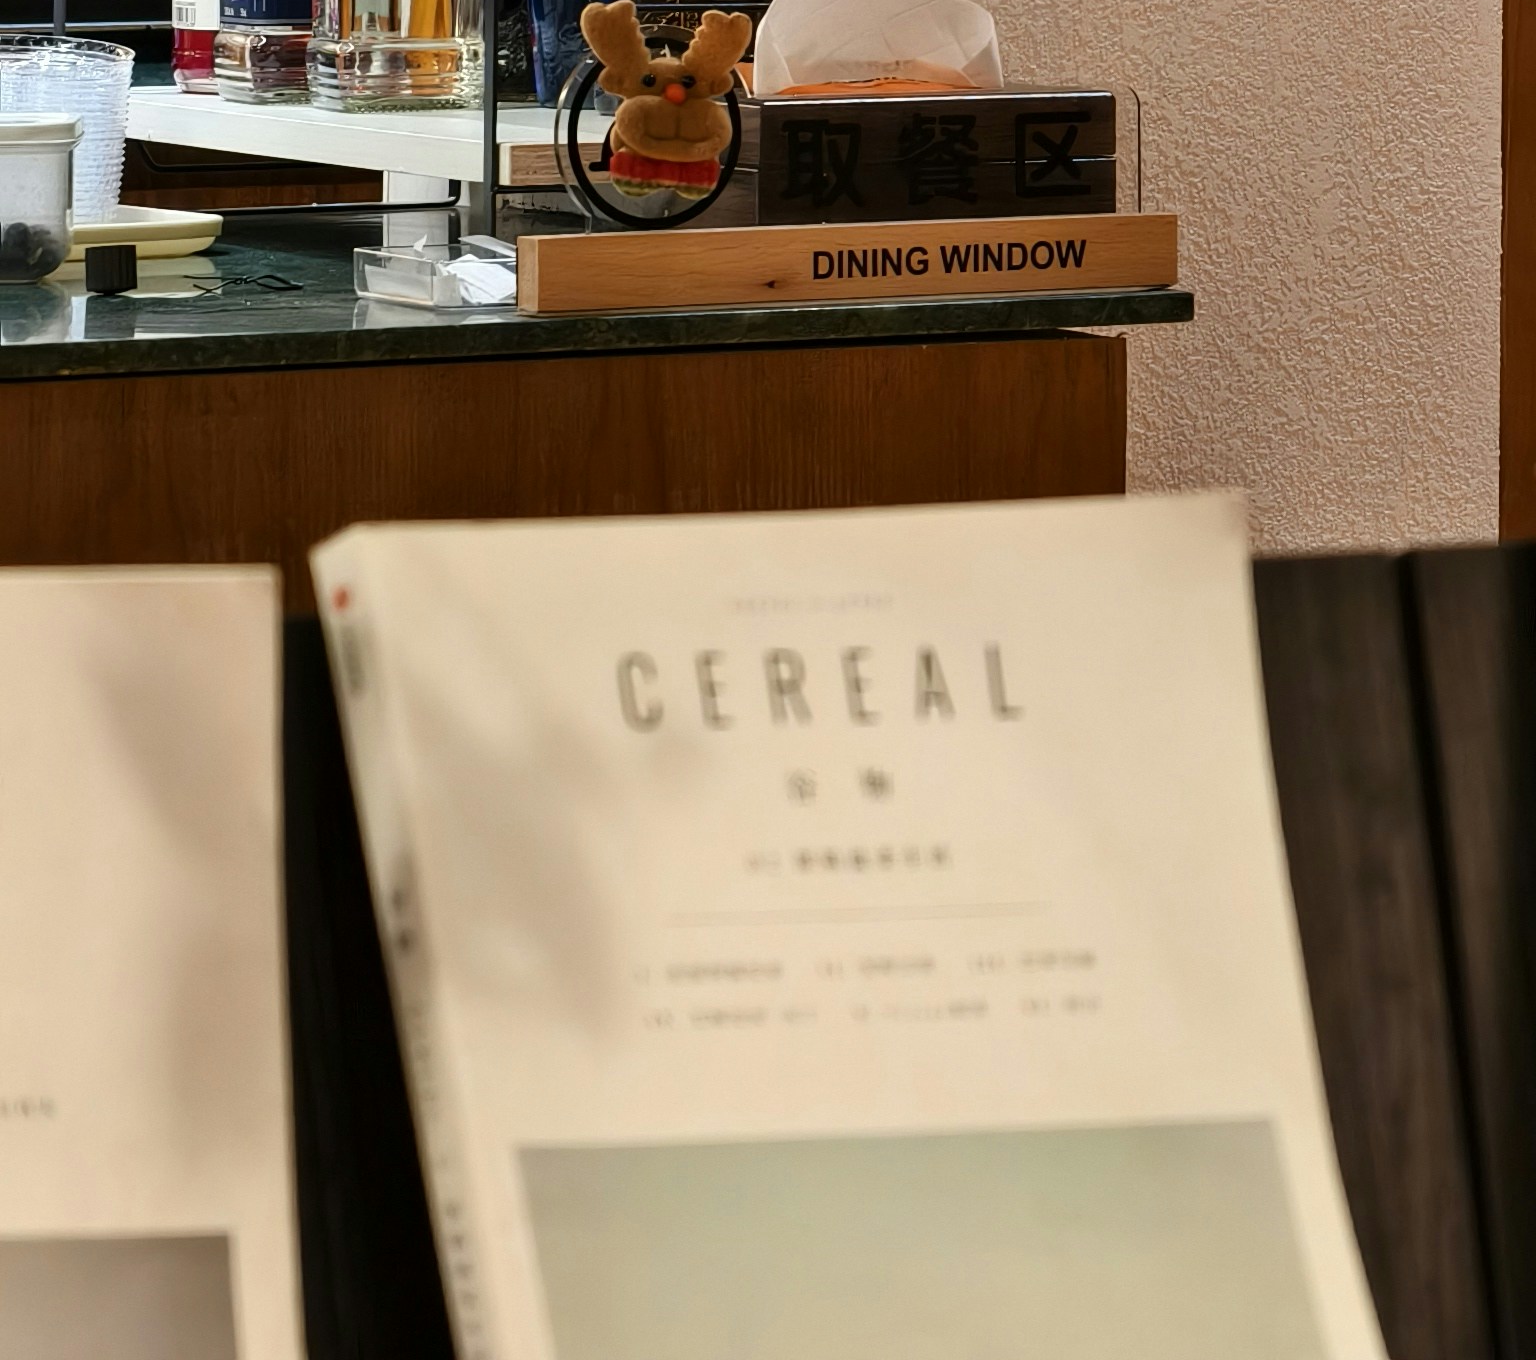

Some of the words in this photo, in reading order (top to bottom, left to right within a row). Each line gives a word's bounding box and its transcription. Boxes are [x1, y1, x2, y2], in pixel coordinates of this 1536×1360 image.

[779, 110, 1092, 208] 取餐区
[812, 246, 930, 280] DINING
[940, 239, 1087, 274] WINDOW
[614, 639, 1027, 734] CEREAL
